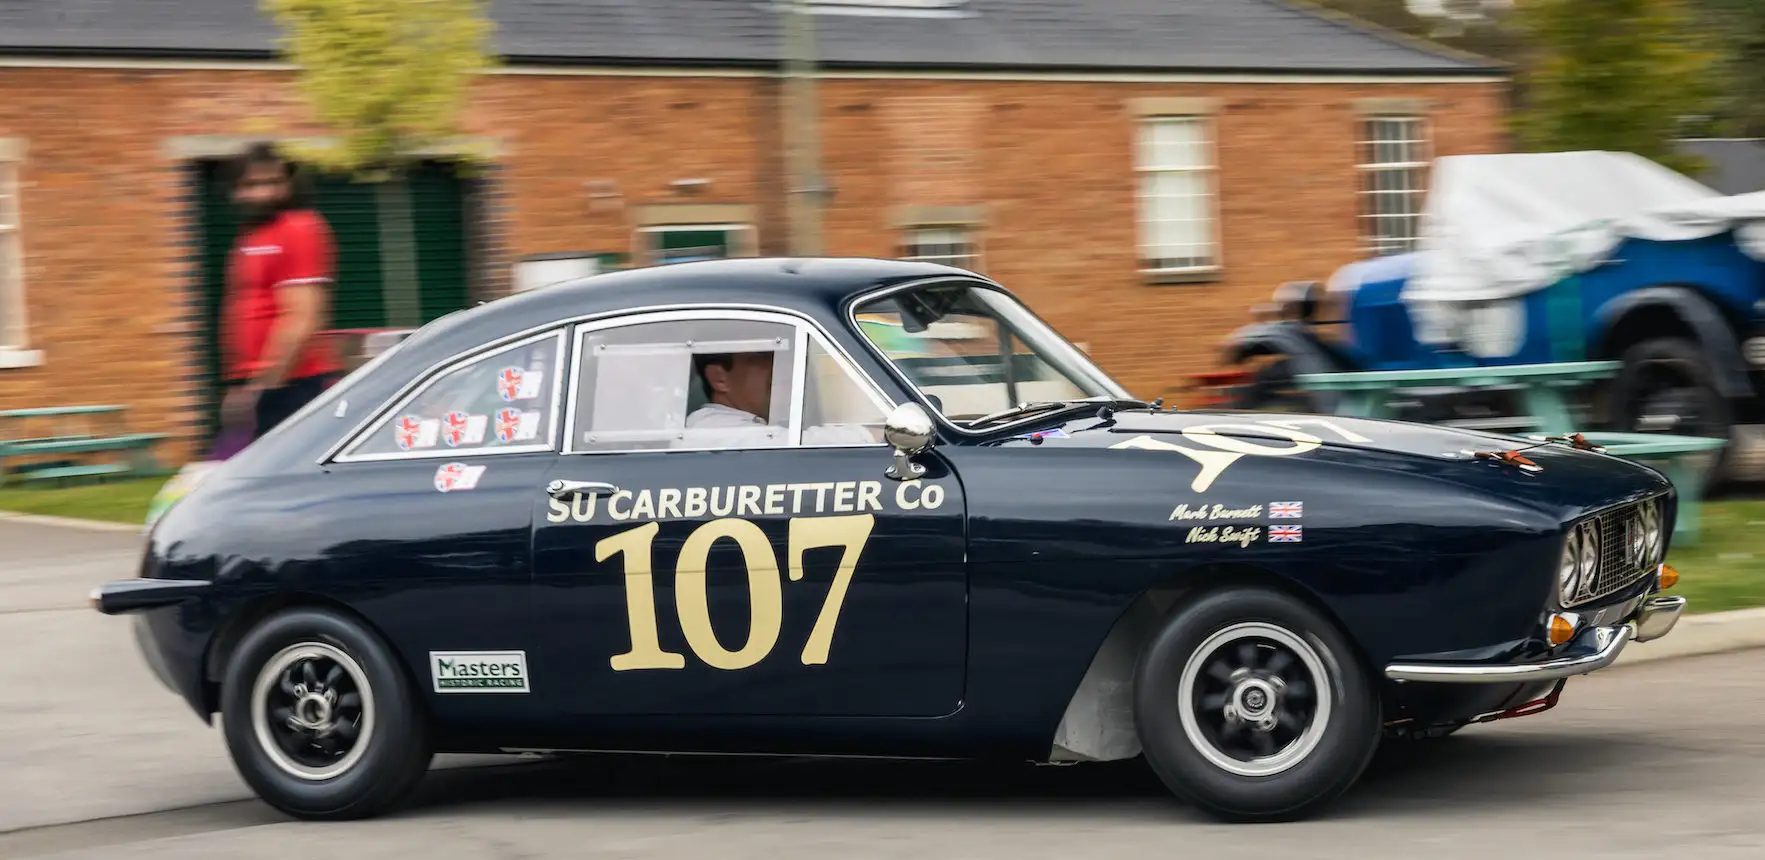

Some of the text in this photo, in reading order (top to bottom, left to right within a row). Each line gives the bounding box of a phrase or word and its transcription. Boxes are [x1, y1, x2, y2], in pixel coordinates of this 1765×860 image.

[1107, 419, 1374, 494] 107
[546, 479, 945, 524] SU CARBURETTER Co
[1169, 504, 1263, 521] Mark Burnett
[1185, 526, 1262, 548] Nick Swift
[595, 513, 875, 671] 107
[437, 658, 521, 677] Masters
[440, 679, 523, 687] HISTORIC RACING
